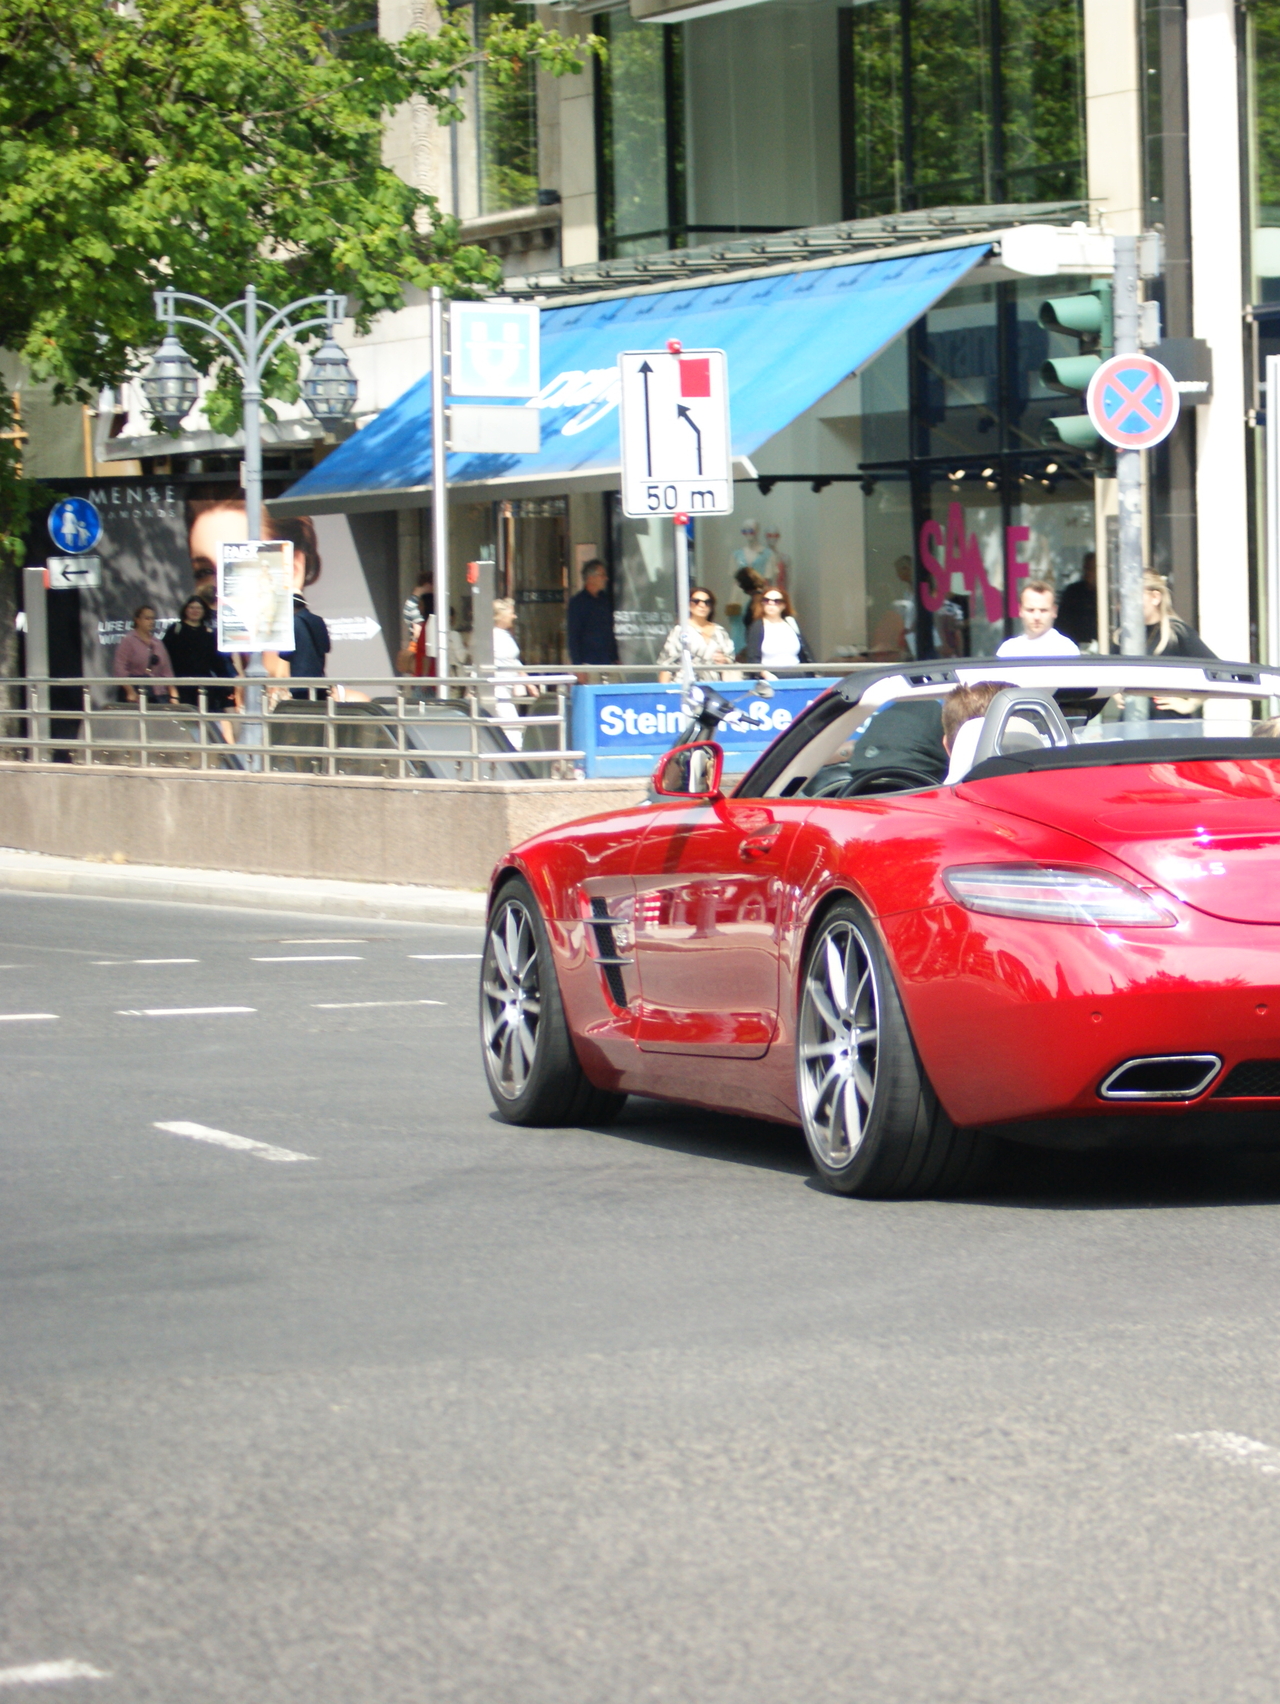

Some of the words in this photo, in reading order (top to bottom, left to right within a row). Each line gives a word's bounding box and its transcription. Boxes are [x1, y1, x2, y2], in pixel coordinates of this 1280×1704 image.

[646, 486, 678, 511] 50
[691, 488, 716, 509] m
[600, 701, 793, 736] Steinße
